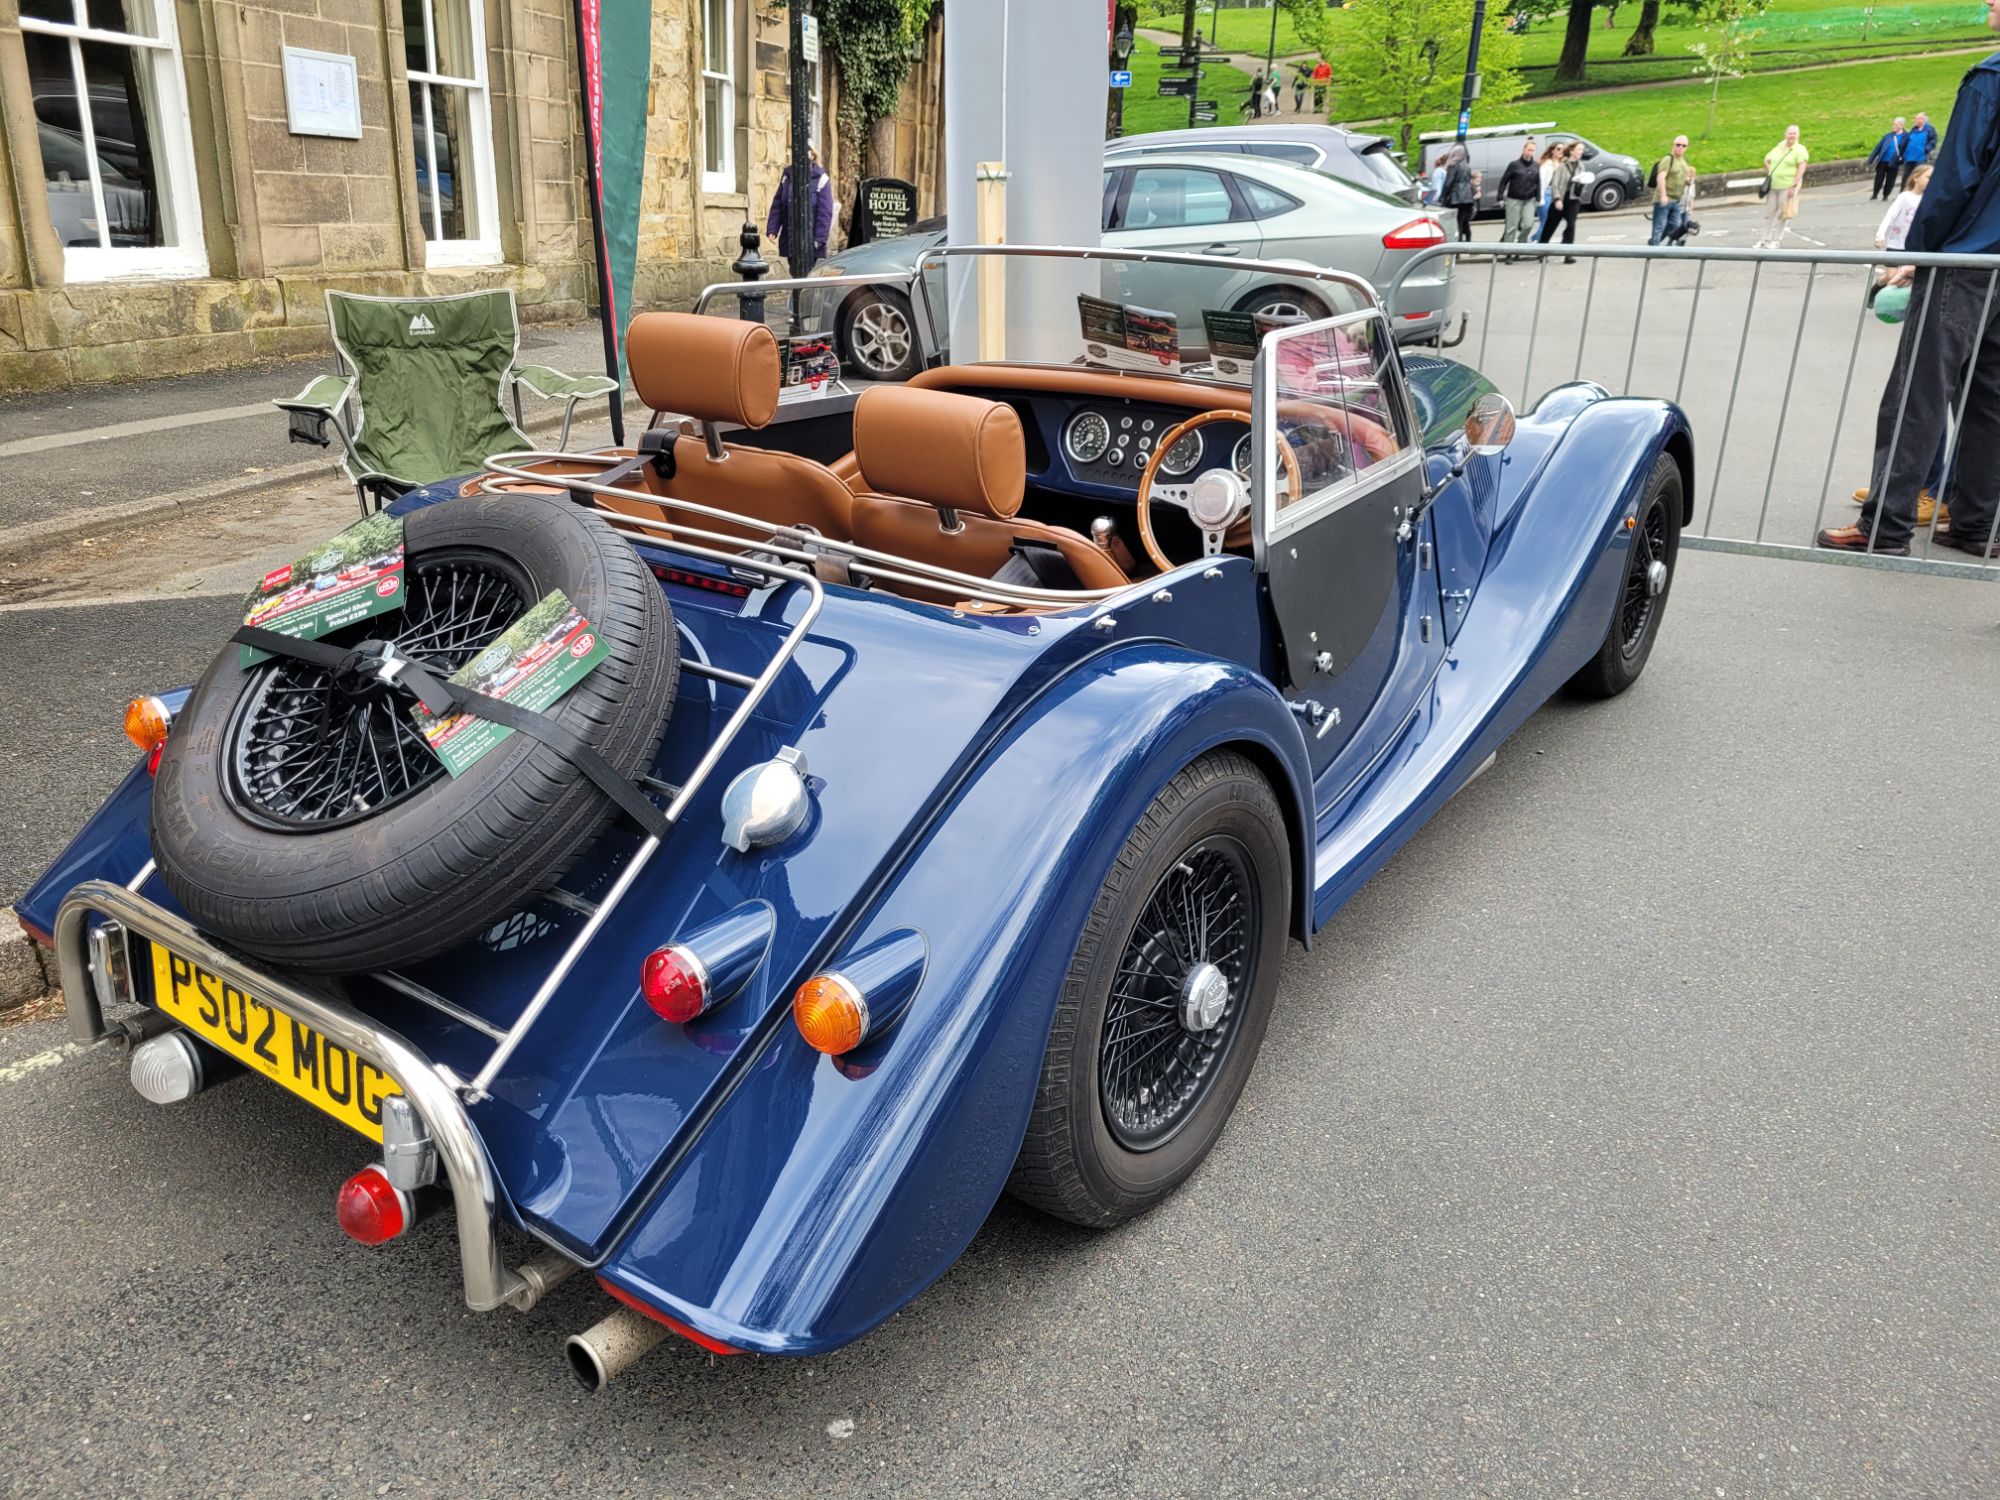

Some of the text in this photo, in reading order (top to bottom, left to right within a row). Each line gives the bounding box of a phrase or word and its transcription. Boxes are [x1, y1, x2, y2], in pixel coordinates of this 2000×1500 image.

[868, 199, 910, 211] HOTEL
[325, 606, 351, 621] Special
[352, 600, 373, 611] Show
[329, 609, 368, 627] Price £199
[299, 621, 314, 630] Cars
[464, 740, 477, 750] Day
[290, 1016, 384, 1126] MOG
